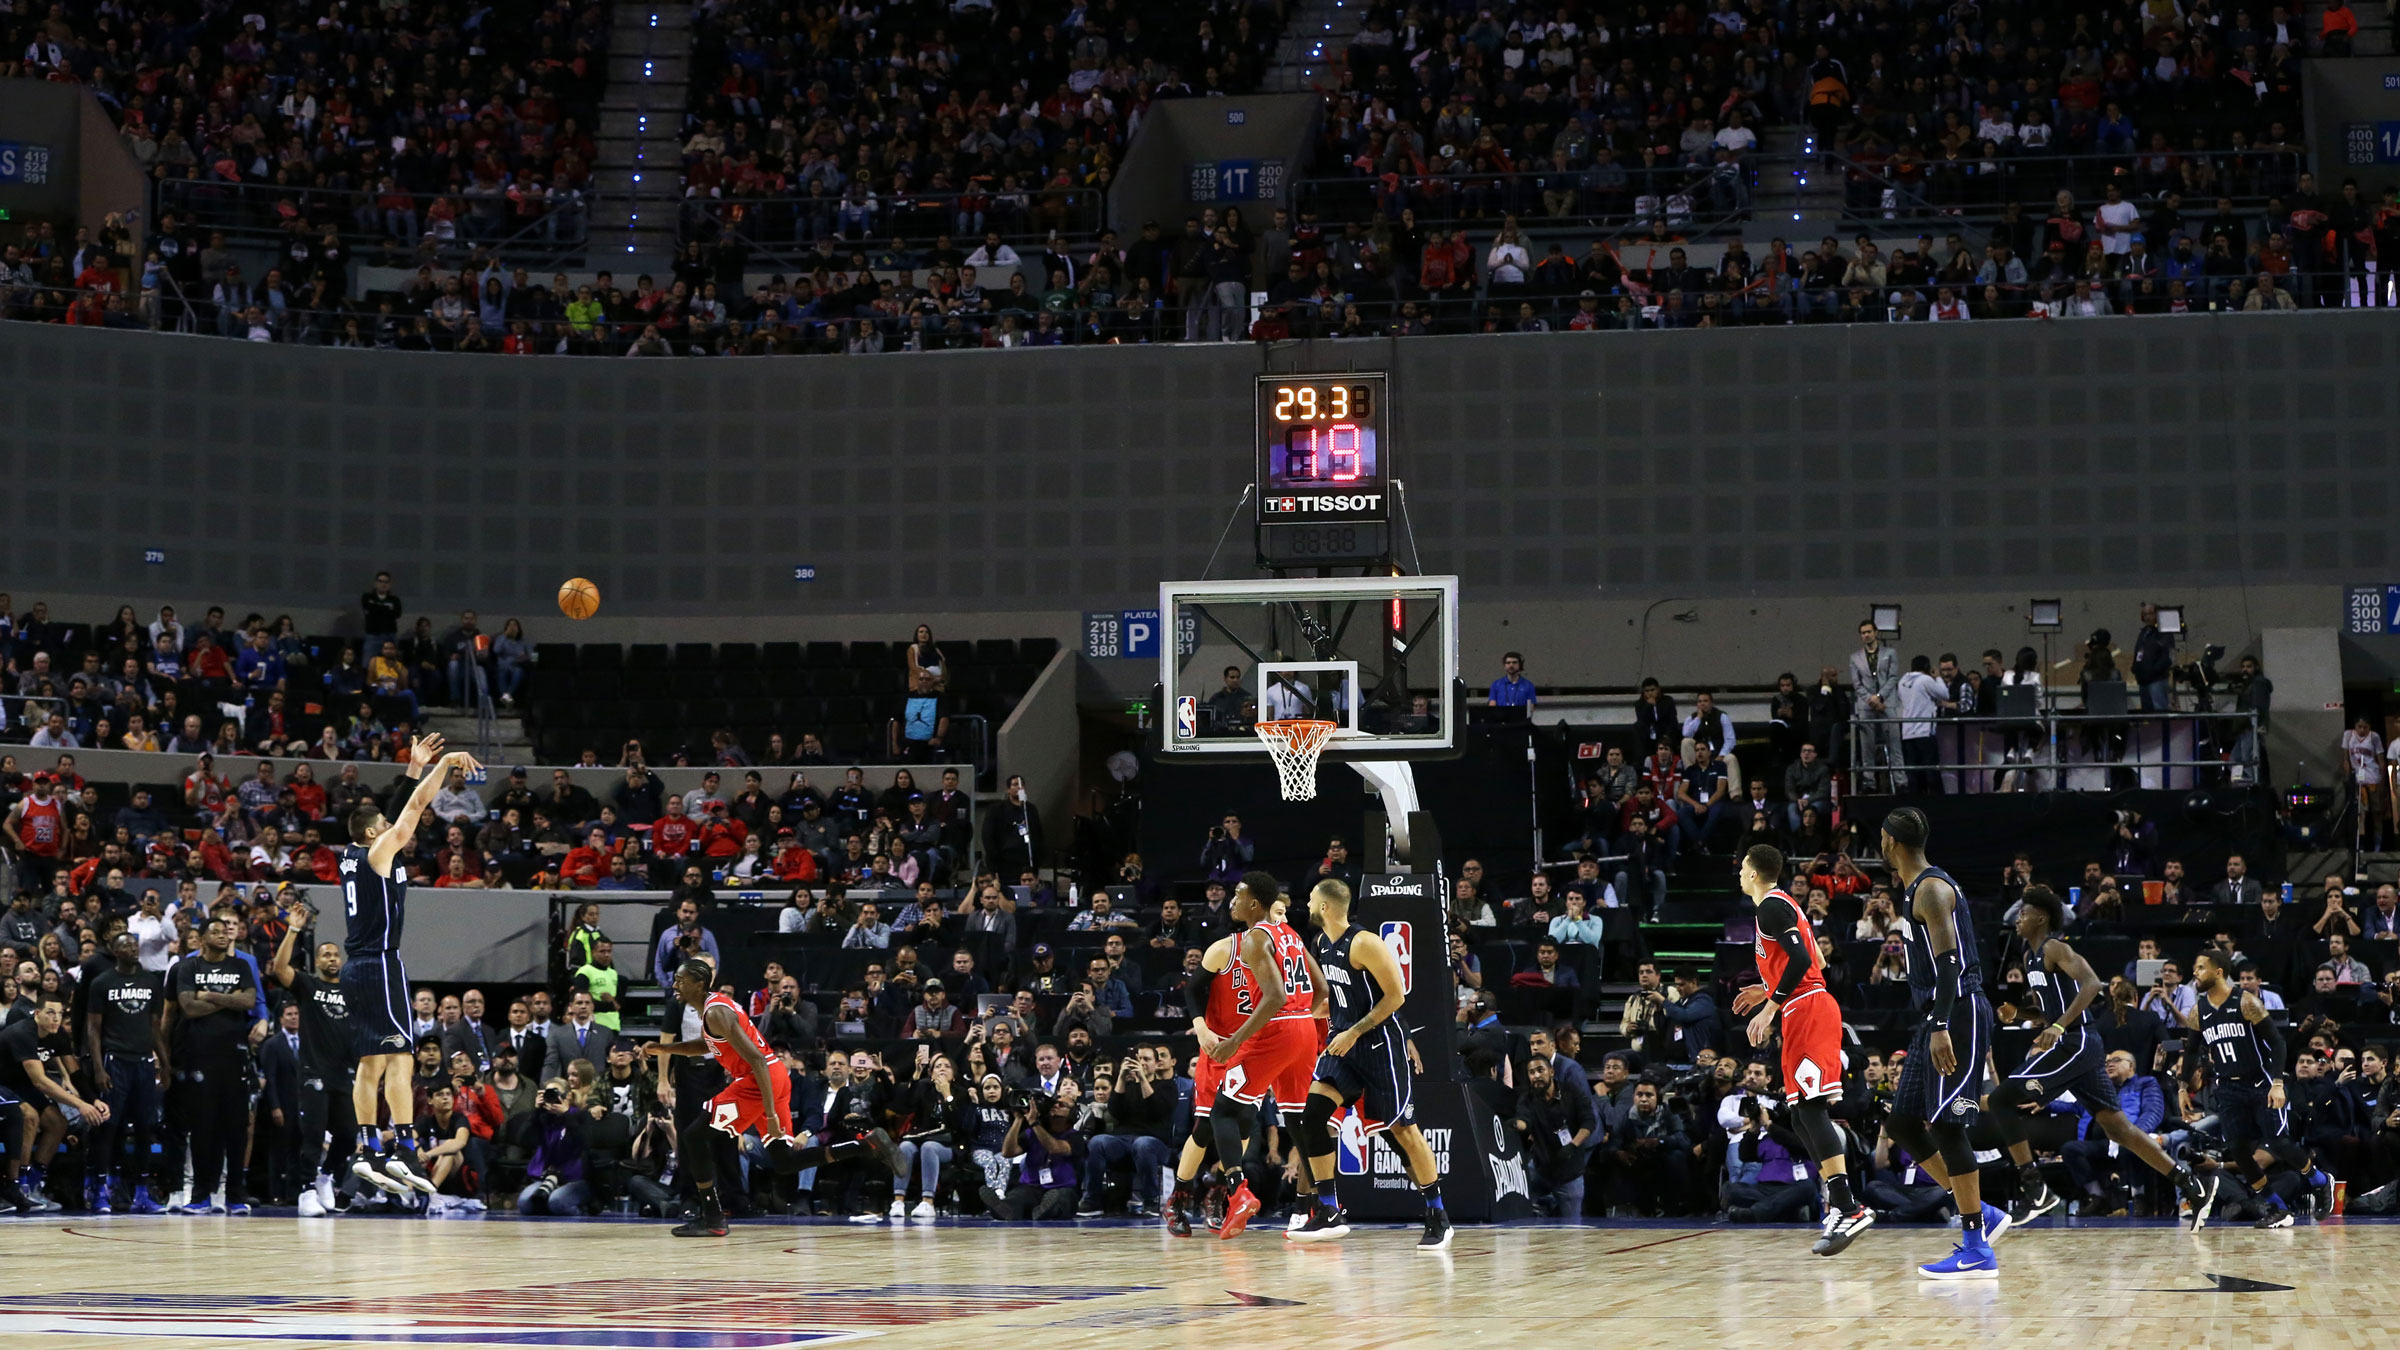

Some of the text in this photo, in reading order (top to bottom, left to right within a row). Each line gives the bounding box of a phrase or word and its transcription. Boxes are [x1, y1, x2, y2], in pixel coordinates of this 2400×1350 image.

[1228, 112, 1244, 123] 500
[2347, 130, 2373, 141] 400
[2348, 141, 2373, 152] 500
[2, 150, 16, 176] S
[24, 151, 49, 163] 419
[2348, 152, 2374, 164] 550
[24, 161, 48, 173] 524
[1258, 166, 1283, 177] 400
[24, 172, 47, 185] 591
[1192, 168, 1217, 179] 419
[1192, 179, 1216, 189] 525
[1223, 168, 1249, 194] 1T
[1192, 190, 1216, 201] 594
[1275, 386, 1348, 420] 29.3
[1297, 495, 1381, 512] TISSOT
[145, 551, 164, 561] 379
[795, 569, 814, 578] 380
[2351, 594, 2380, 606] 200
[1124, 611, 1158, 619] PLATEA
[2352, 607, 2381, 619] 300
[1090, 621, 1118, 633] 219
[2352, 620, 2381, 633] 350
[1090, 633, 1118, 644] 315
[1128, 623, 1150, 652] P
[1090, 645, 1118, 657] 380
[1370, 884, 1423, 897] SPALDING
[346, 880, 358, 917] 9
[195, 973, 241, 985] EL MAGIC
[1283, 955, 1314, 995] 34
[108, 988, 152, 1000] EL MAGIC
[313, 990, 326, 1001] EL
[1331, 983, 1348, 1009] 10
[2202, 1022, 2246, 1045] ORLANDO
[2216, 1041, 2237, 1063] 14
[1423, 1128, 1452, 1151] CITY
[1488, 1151, 1529, 1202] SPALDING
[1373, 1177, 1409, 1191] Presented by
